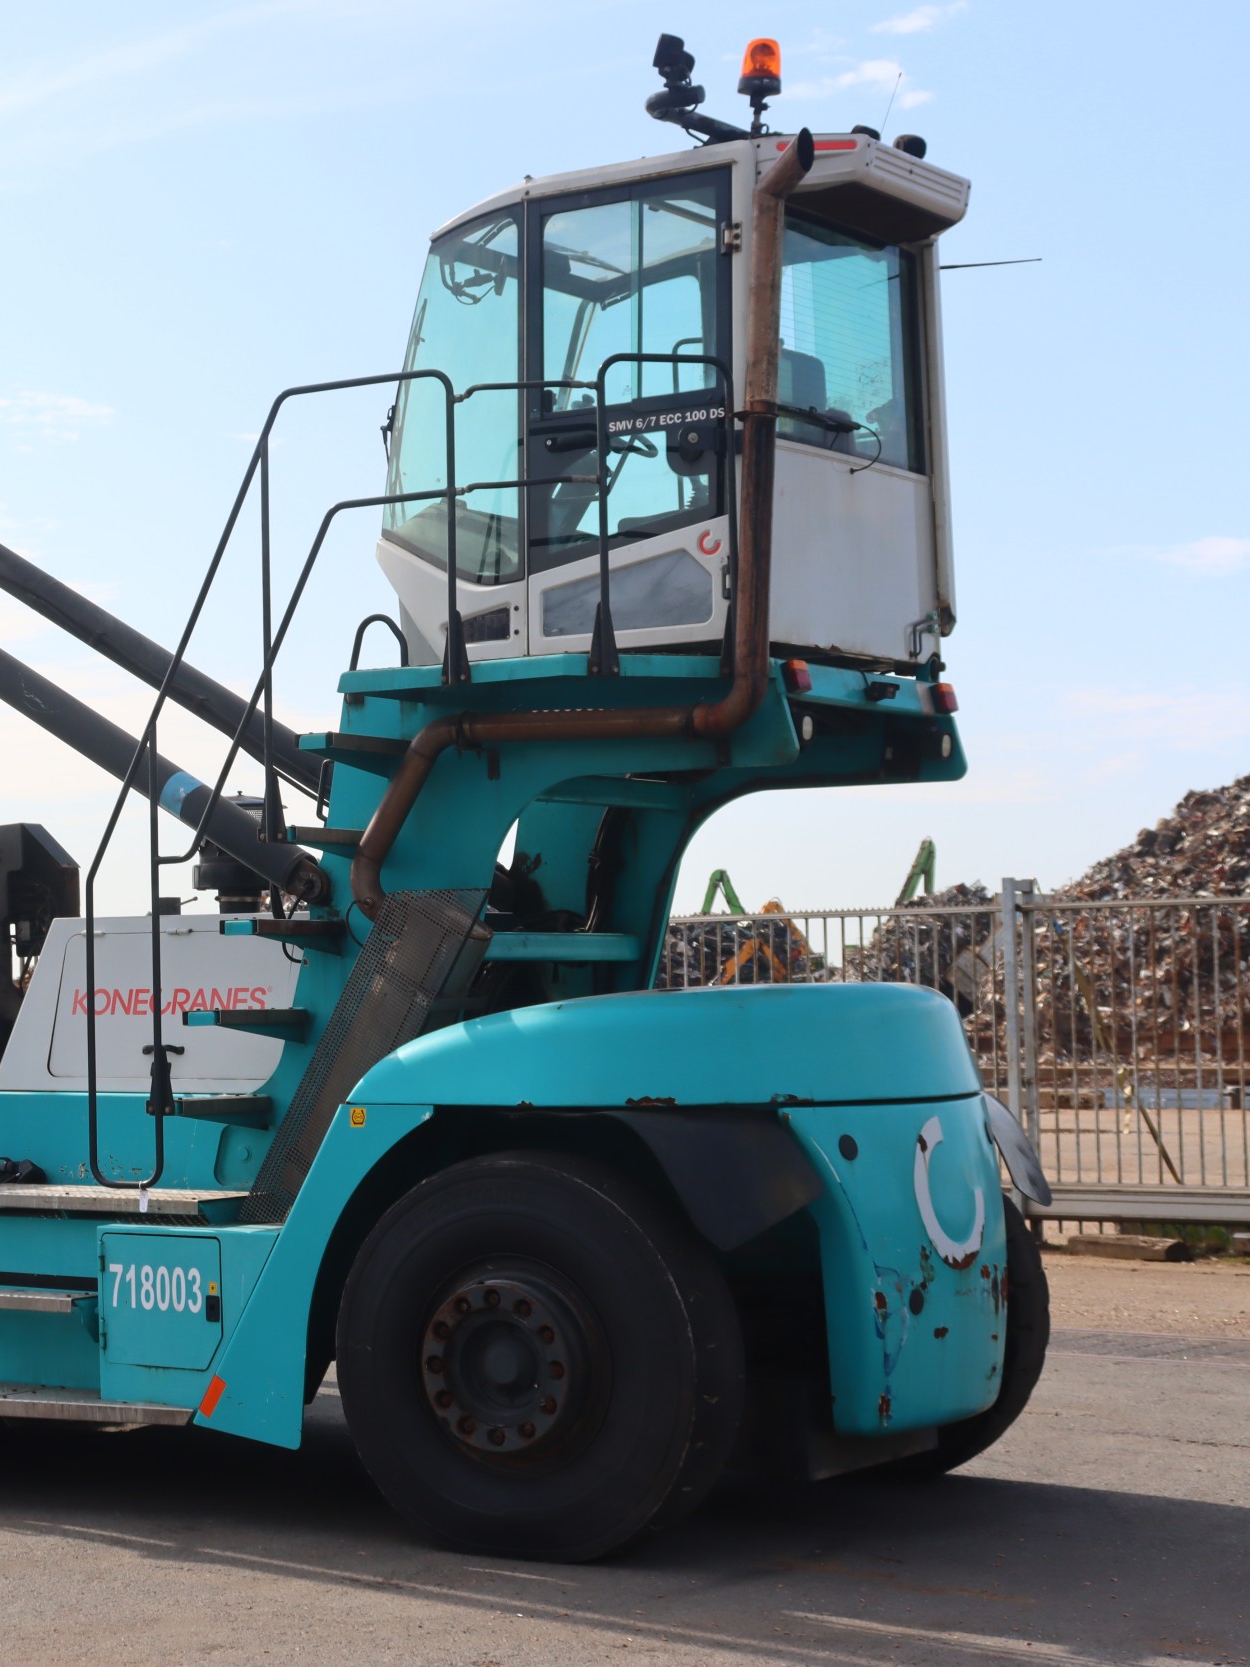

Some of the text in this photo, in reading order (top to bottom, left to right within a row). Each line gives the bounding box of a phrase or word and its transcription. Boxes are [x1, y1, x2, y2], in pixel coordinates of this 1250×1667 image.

[608, 407, 726, 432] SMV 6/7 ECC 100 DS
[109, 1263, 203, 1314] 718003
